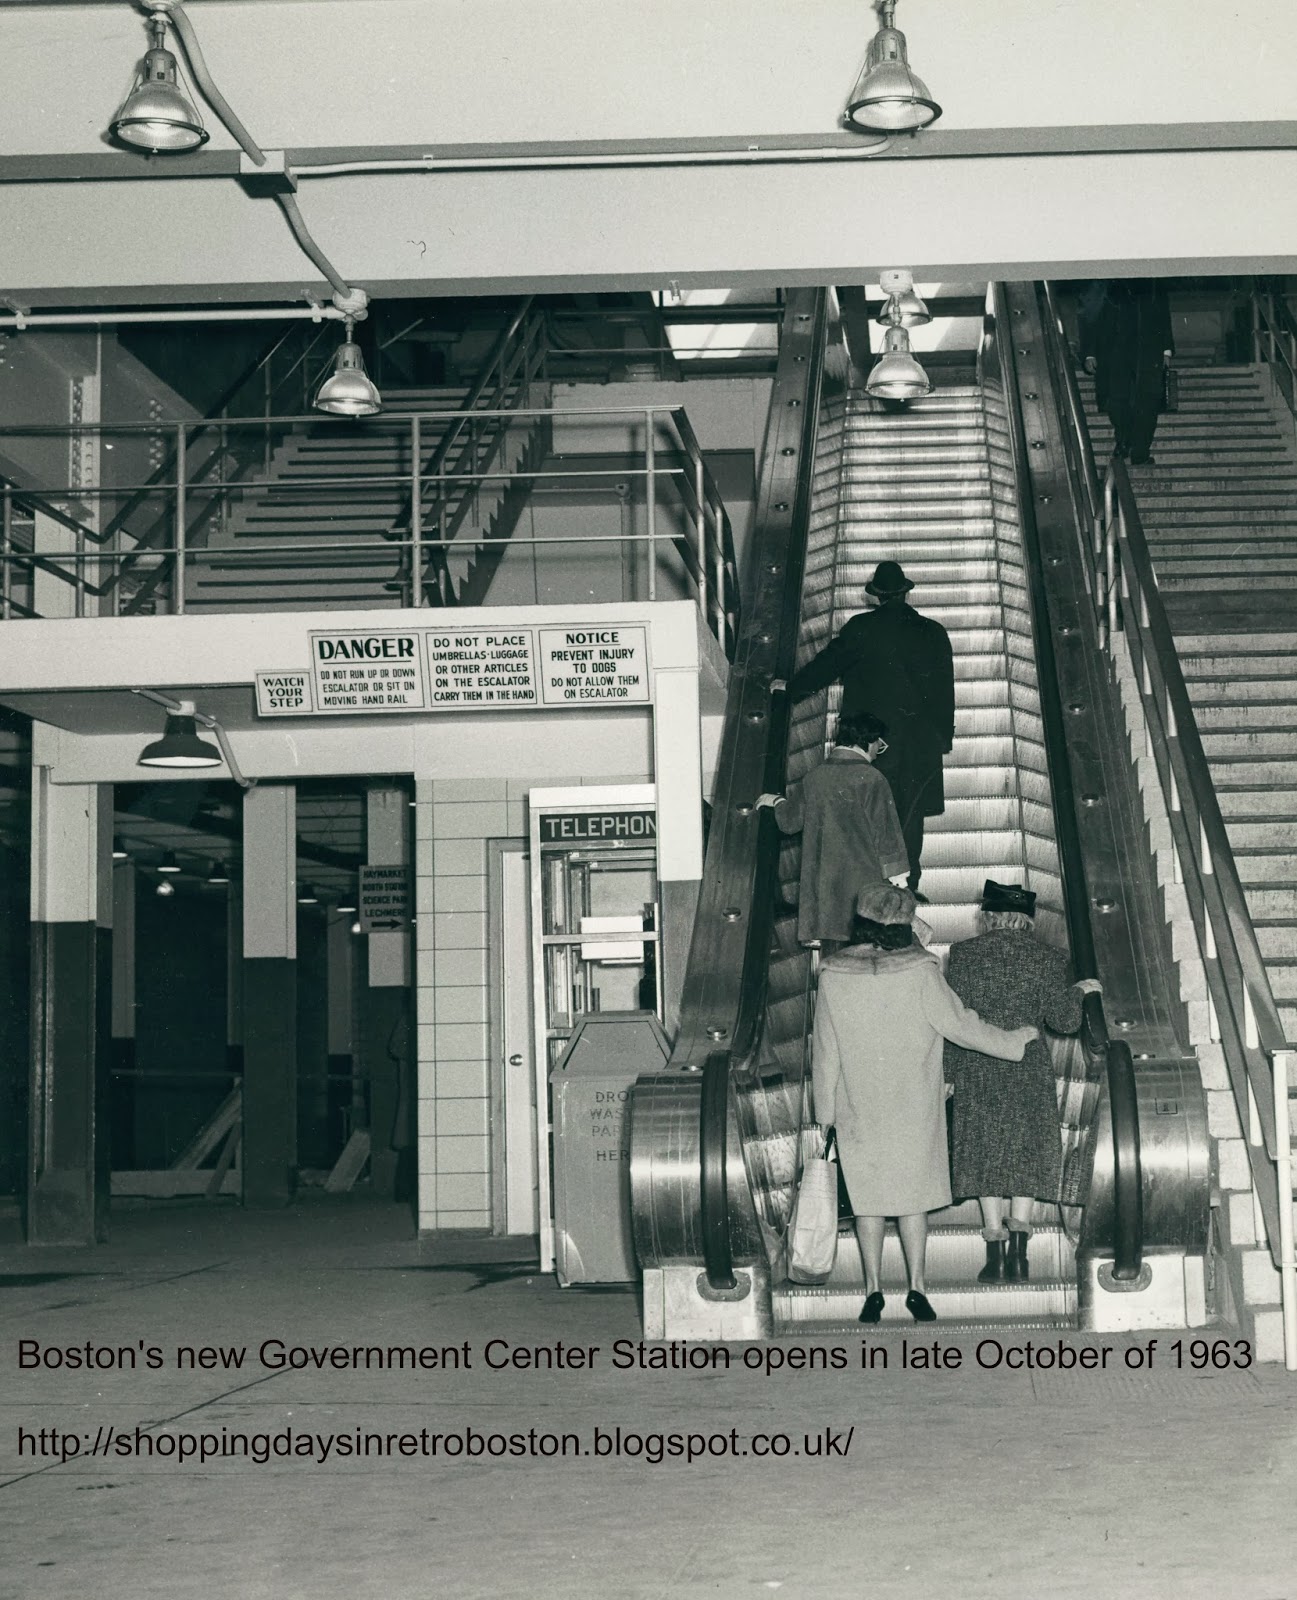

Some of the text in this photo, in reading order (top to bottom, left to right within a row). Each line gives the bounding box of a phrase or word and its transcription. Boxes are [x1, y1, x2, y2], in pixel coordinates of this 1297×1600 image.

[434, 636, 525, 648] DO NOT PLACE
[566, 632, 619, 644] NOTICE
[318, 638, 414, 660] DANGER
[551, 649, 634, 661] PREVENT INJURY
[436, 663, 528, 674] OR OTHER ARTICLES
[573, 662, 616, 673] TO DOGS
[321, 668, 415, 679] DO NOT RUN UP OR DOWN
[263, 677, 304, 687] WATCH
[323, 681, 415, 693] ESCALATOR OR SIT ON
[436, 676, 530, 688] ON THE ESCALATOR
[551, 676, 639, 687] DO NOT ALLOW THEM
[267, 688, 302, 697] YOUR
[434, 690, 534, 701] CARRY THEM IN THE HAND
[564, 688, 628, 699] ON ESCALATOR
[270, 698, 303, 707] STEP
[324, 694, 408, 705] MOVING HAND RAIL
[365, 909, 407, 917] LECHMERE
